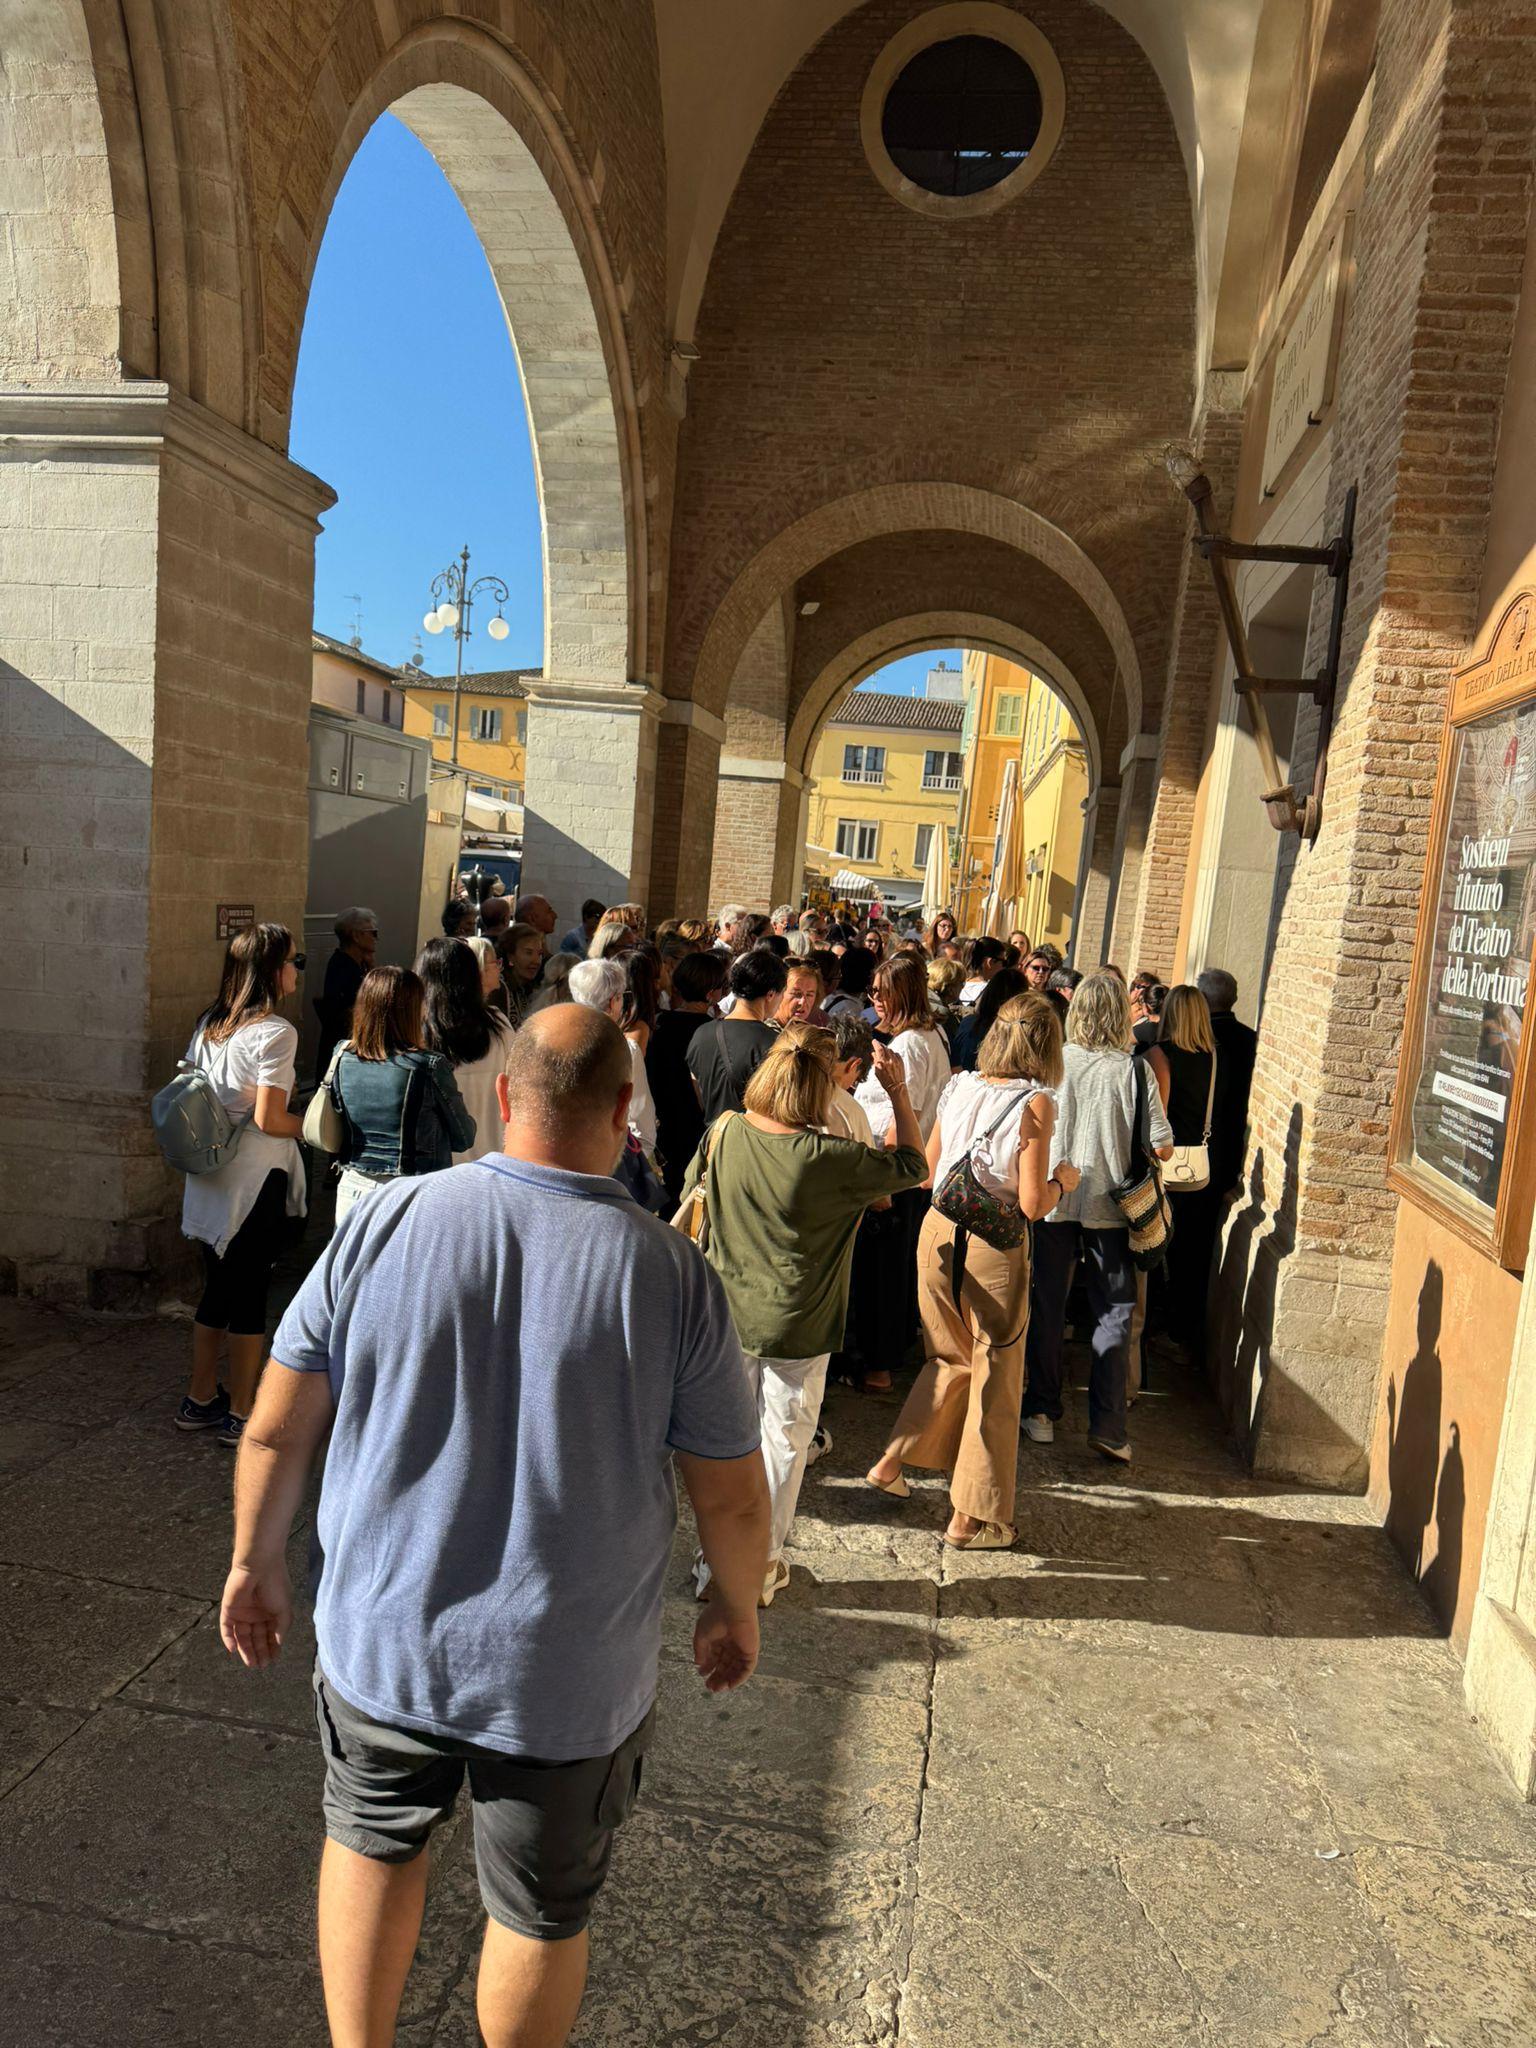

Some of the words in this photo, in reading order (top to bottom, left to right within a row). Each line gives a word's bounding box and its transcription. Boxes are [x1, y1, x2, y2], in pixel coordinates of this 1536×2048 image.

[1465, 670, 1495, 700] TEATRO
[1496, 656, 1522, 685] DELLA
[1460, 828, 1512, 870] Sostieni
[1453, 873, 1463, 910] il
[1461, 873, 1503, 912] futuro
[1448, 914, 1466, 953] del
[1466, 917, 1511, 957] Teatro
[1442, 955, 1467, 997] della
[1469, 962, 1528, 1008] Fortuna
